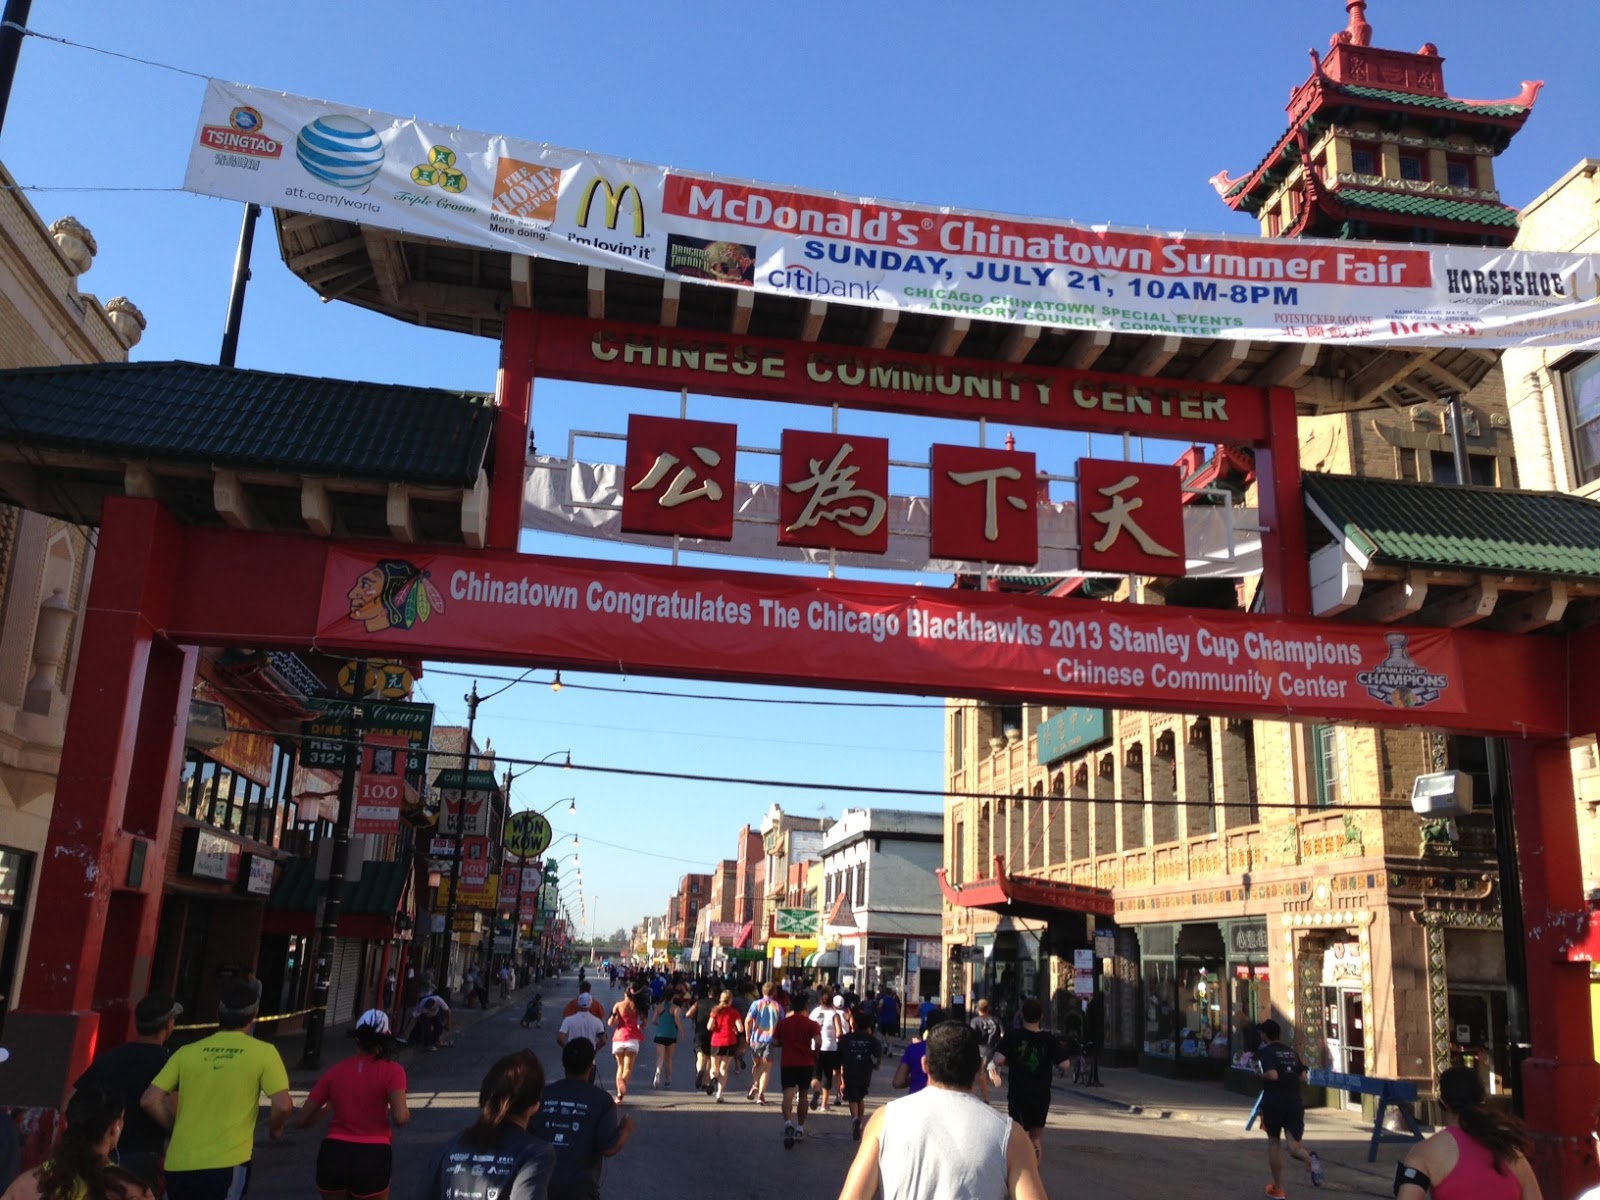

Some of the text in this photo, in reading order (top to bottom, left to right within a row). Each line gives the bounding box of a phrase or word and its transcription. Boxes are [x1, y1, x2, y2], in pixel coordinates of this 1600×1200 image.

[207, 130, 277, 153] TSINGTAO
[503, 166, 531, 188] THE
[285, 187, 380, 213] att.com/world
[394, 191, 478, 214] Triple Crown
[492, 167, 559, 214] HOME
[516, 186, 558, 222] DEPOT
[489, 223, 515, 235] More
[490, 213, 516, 225] More
[568, 232, 651, 260] i'm lovin' it
[688, 185, 1407, 284] McDonald's Chinatown Summer Fair
[768, 267, 880, 301] citibank
[804, 240, 1299, 306] SUNDAY, JULY 21, 10AM-8PM
[1446, 268, 1566, 297] HORSESHOE
[903, 286, 1244, 327] CHICAGO CHINATOWN SPECIAL EVENTS
[929, 302, 1222, 336] ADVISORY COUNCIL COMMITTEE
[1274, 312, 1375, 326] POTSTICKER HOUSE
[591, 330, 1230, 422] CHINESE COMMUNITY CENTER
[631, 443, 1180, 558] 公 為 下 天
[450, 569, 1363, 670] Chinatown Congratulates The Chicago Blackhawks 2013 Stanley Cup Champions
[1056, 657, 1145, 686] Chinese
[1151, 663, 1273, 700] Community
[1278, 673, 1347, 698] Center
[1357, 671, 1448, 688] CHAMPIONS
[1376, 666, 1426, 675] STANLEY CUP
[371, 704, 425, 723] Crown
[443, 774, 490, 784] CATRING
[362, 784, 398, 800] 100
[512, 818, 544, 835] WON
[511, 834, 543, 850] KOW
[464, 864, 483, 873] 100
